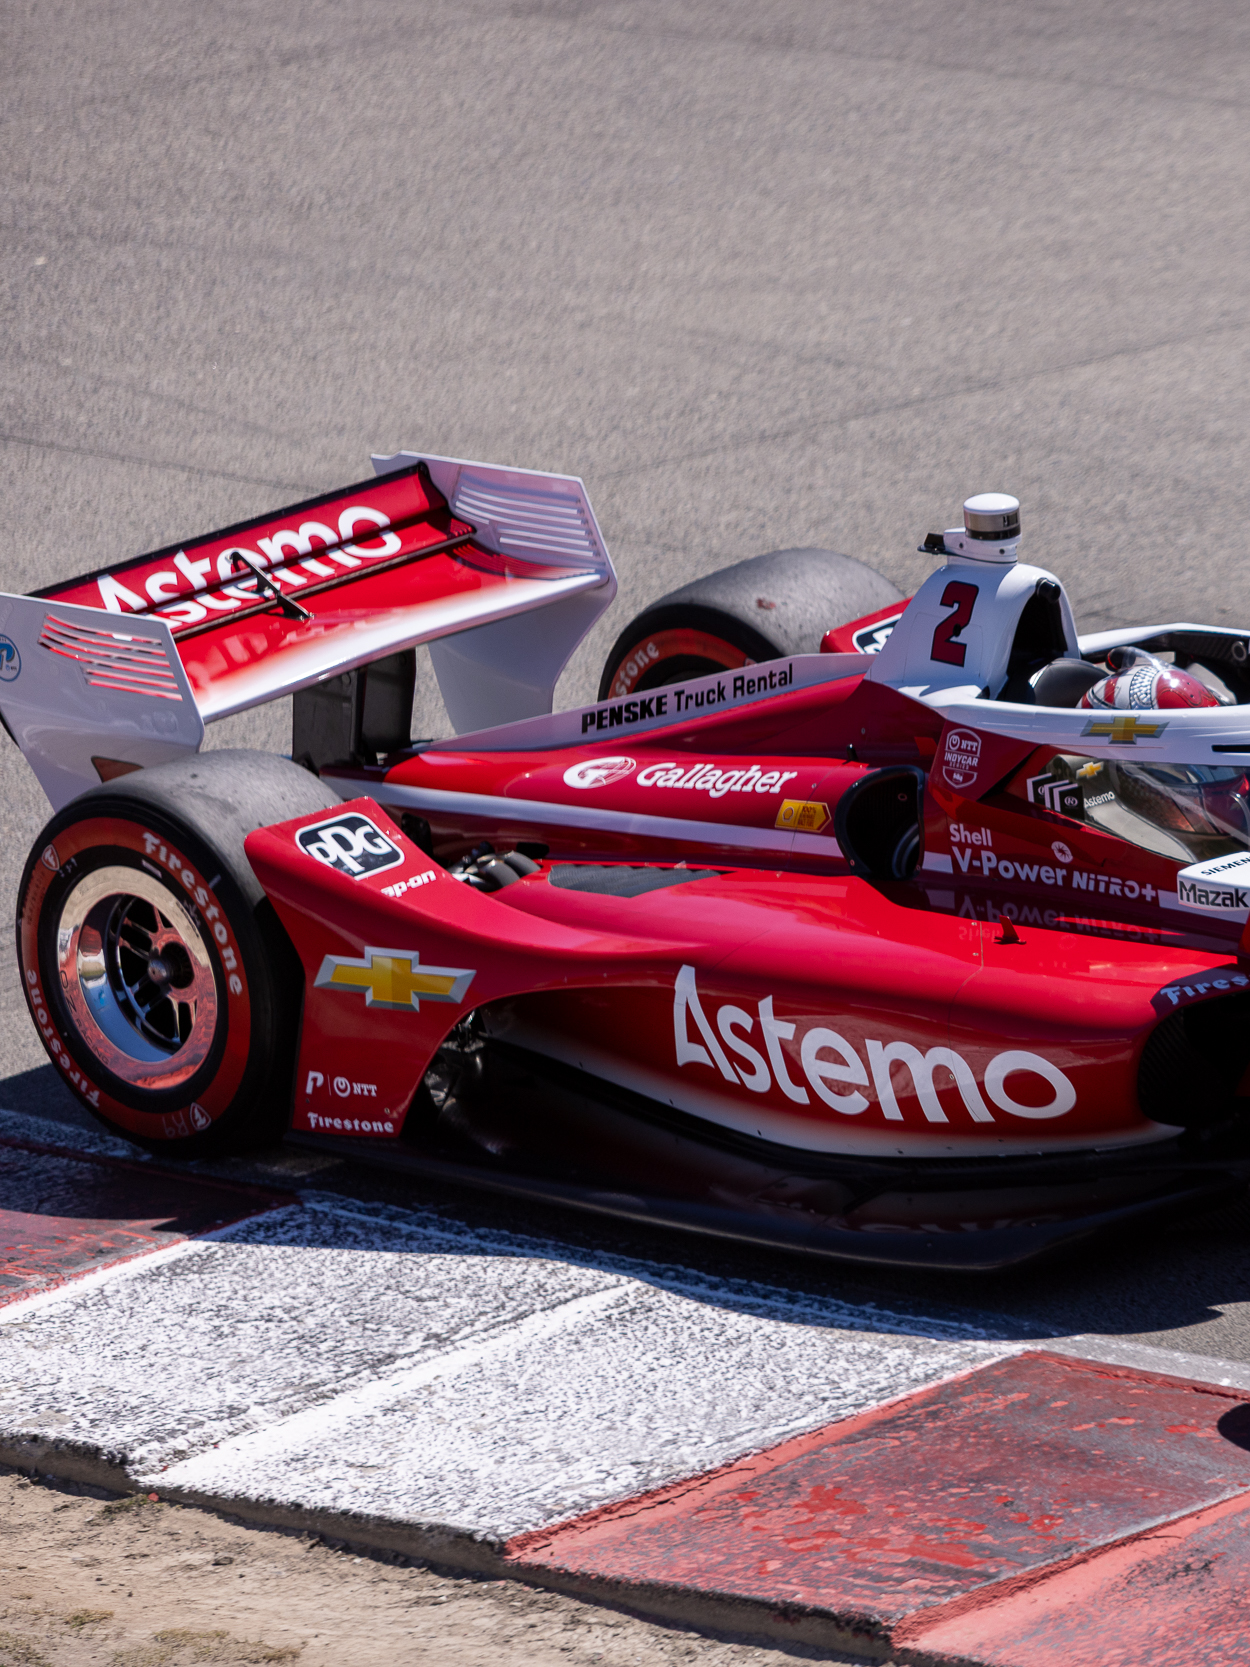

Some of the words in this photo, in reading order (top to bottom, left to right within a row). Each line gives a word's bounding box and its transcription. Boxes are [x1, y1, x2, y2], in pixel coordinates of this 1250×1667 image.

[97, 506, 402, 629] Astemo
[930, 580, 979, 668] 2
[610, 642, 659, 699] stone
[581, 694, 668, 734] PENSKE
[674, 680, 727, 712] Truck
[733, 663, 793, 699] Rental
[944, 751, 979, 767] INDYCAR
[960, 739, 978, 751] NTT
[636, 762, 798, 798] Gallagher
[1083, 790, 1116, 808] Astemo
[950, 823, 993, 847] Shell
[380, 870, 437, 897] ap-on
[952, 846, 1067, 886] V-Power
[1179, 880, 1250, 908] Mazak
[143, 832, 244, 996] Firestone
[26, 969, 100, 1108] Firestone
[673, 964, 1077, 1124] Astemo
[352, 1082, 377, 1097] NTT
[307, 1112, 394, 1133] Firestone
